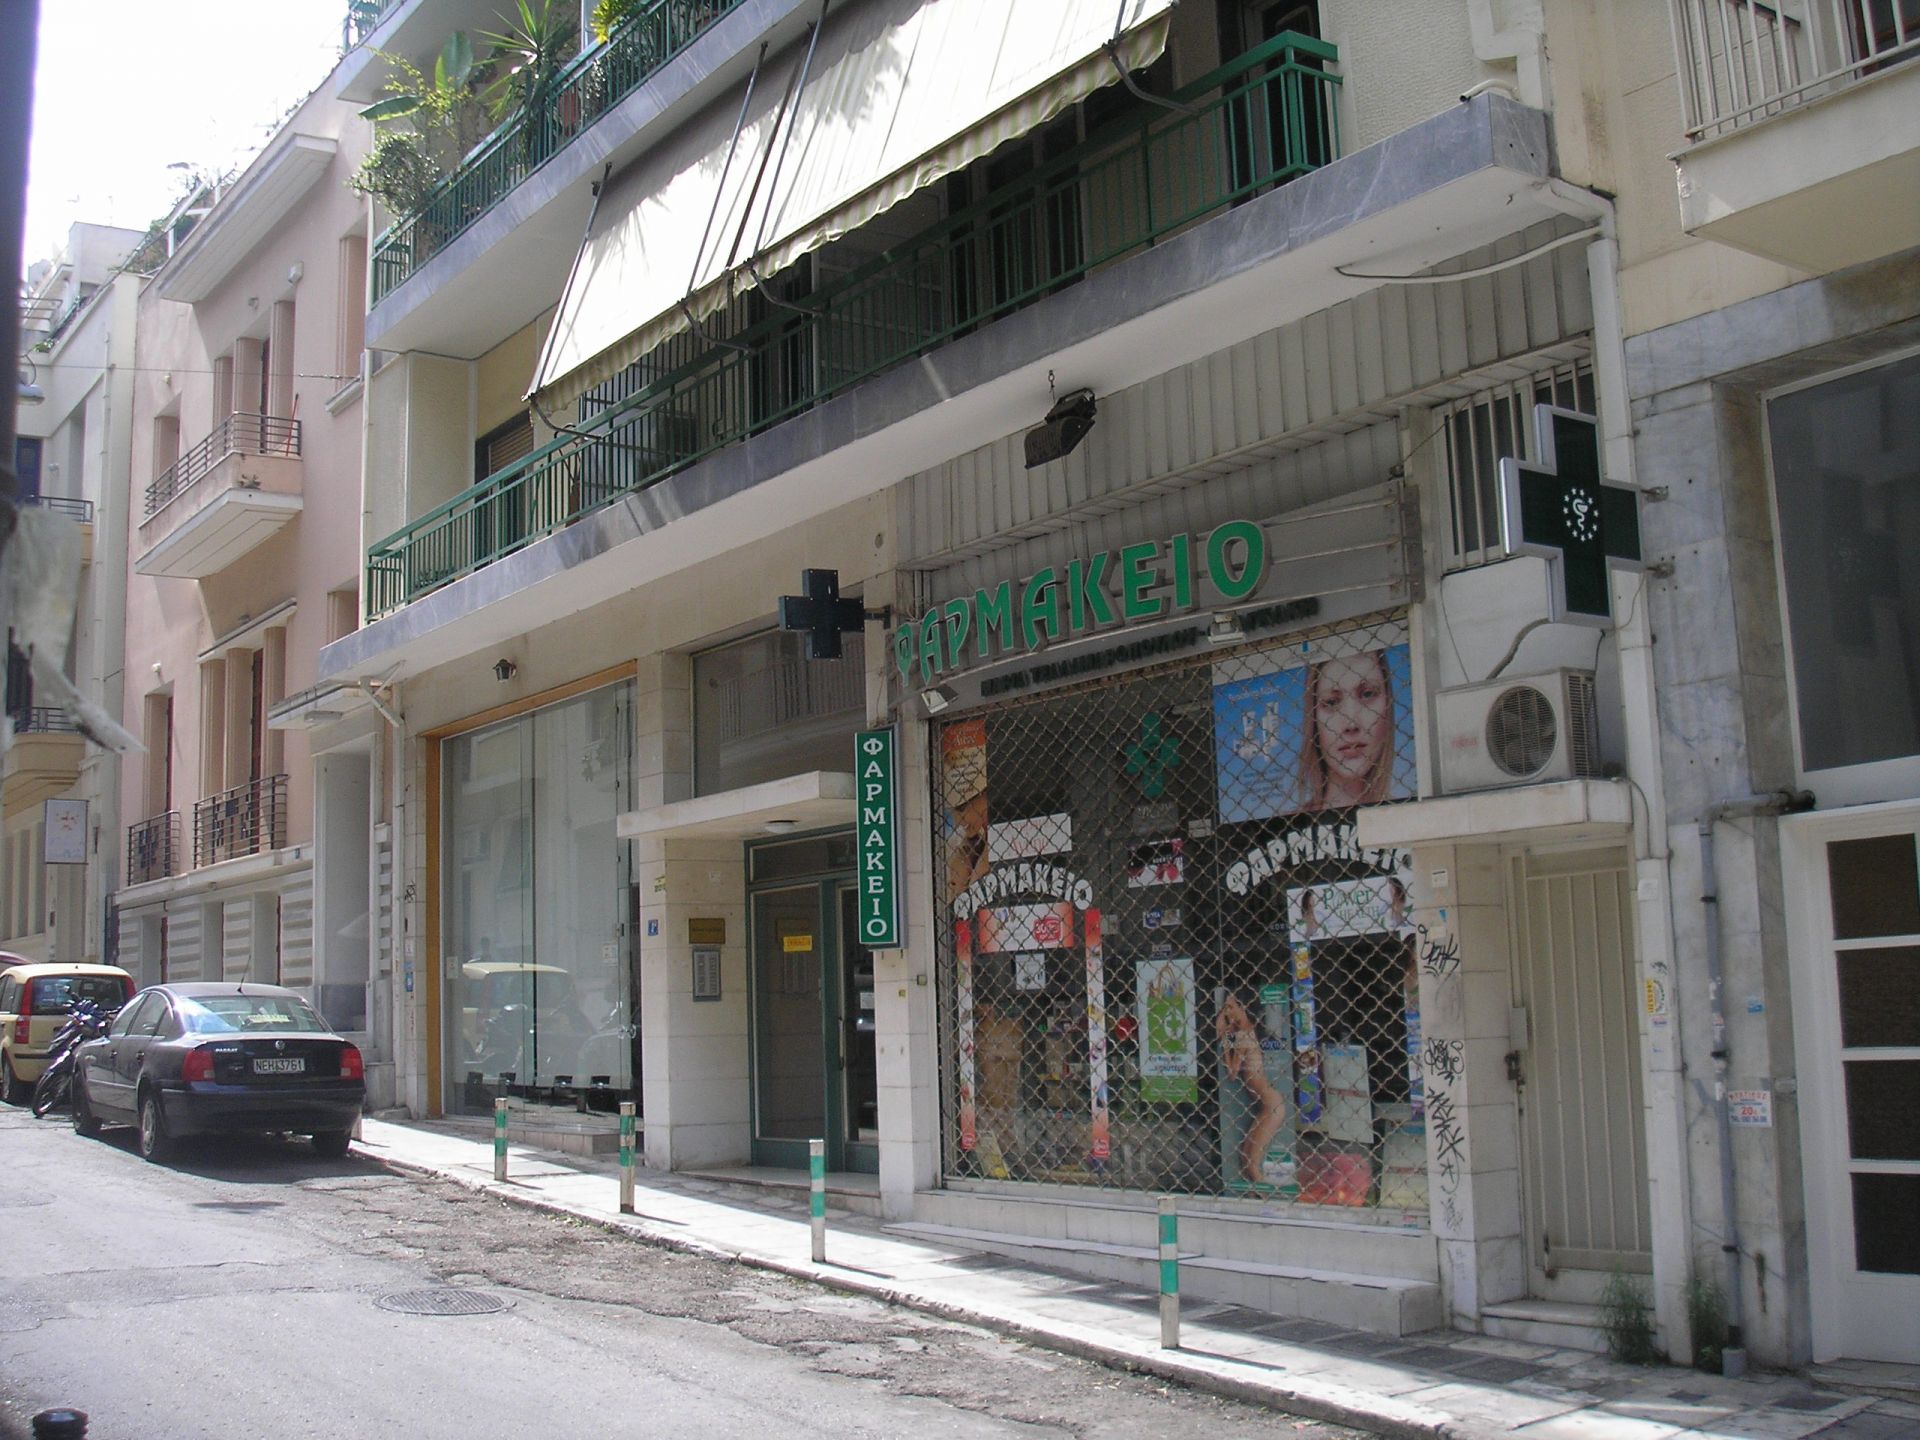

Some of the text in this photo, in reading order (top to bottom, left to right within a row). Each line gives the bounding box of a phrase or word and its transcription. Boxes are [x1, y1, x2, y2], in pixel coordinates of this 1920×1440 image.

[894, 519, 1266, 686] ΦΑΡΜΑΚΕΙΟ
[862, 737, 888, 937] ΦΑΡΜΑΚΕΙΟ
[1226, 824, 1413, 897] ΦΑΡΜΑΚΕΙΟ
[953, 863, 1093, 920] ΦΑΡΜΑΚΕΙΟ
[1322, 887, 1372, 909] Power
